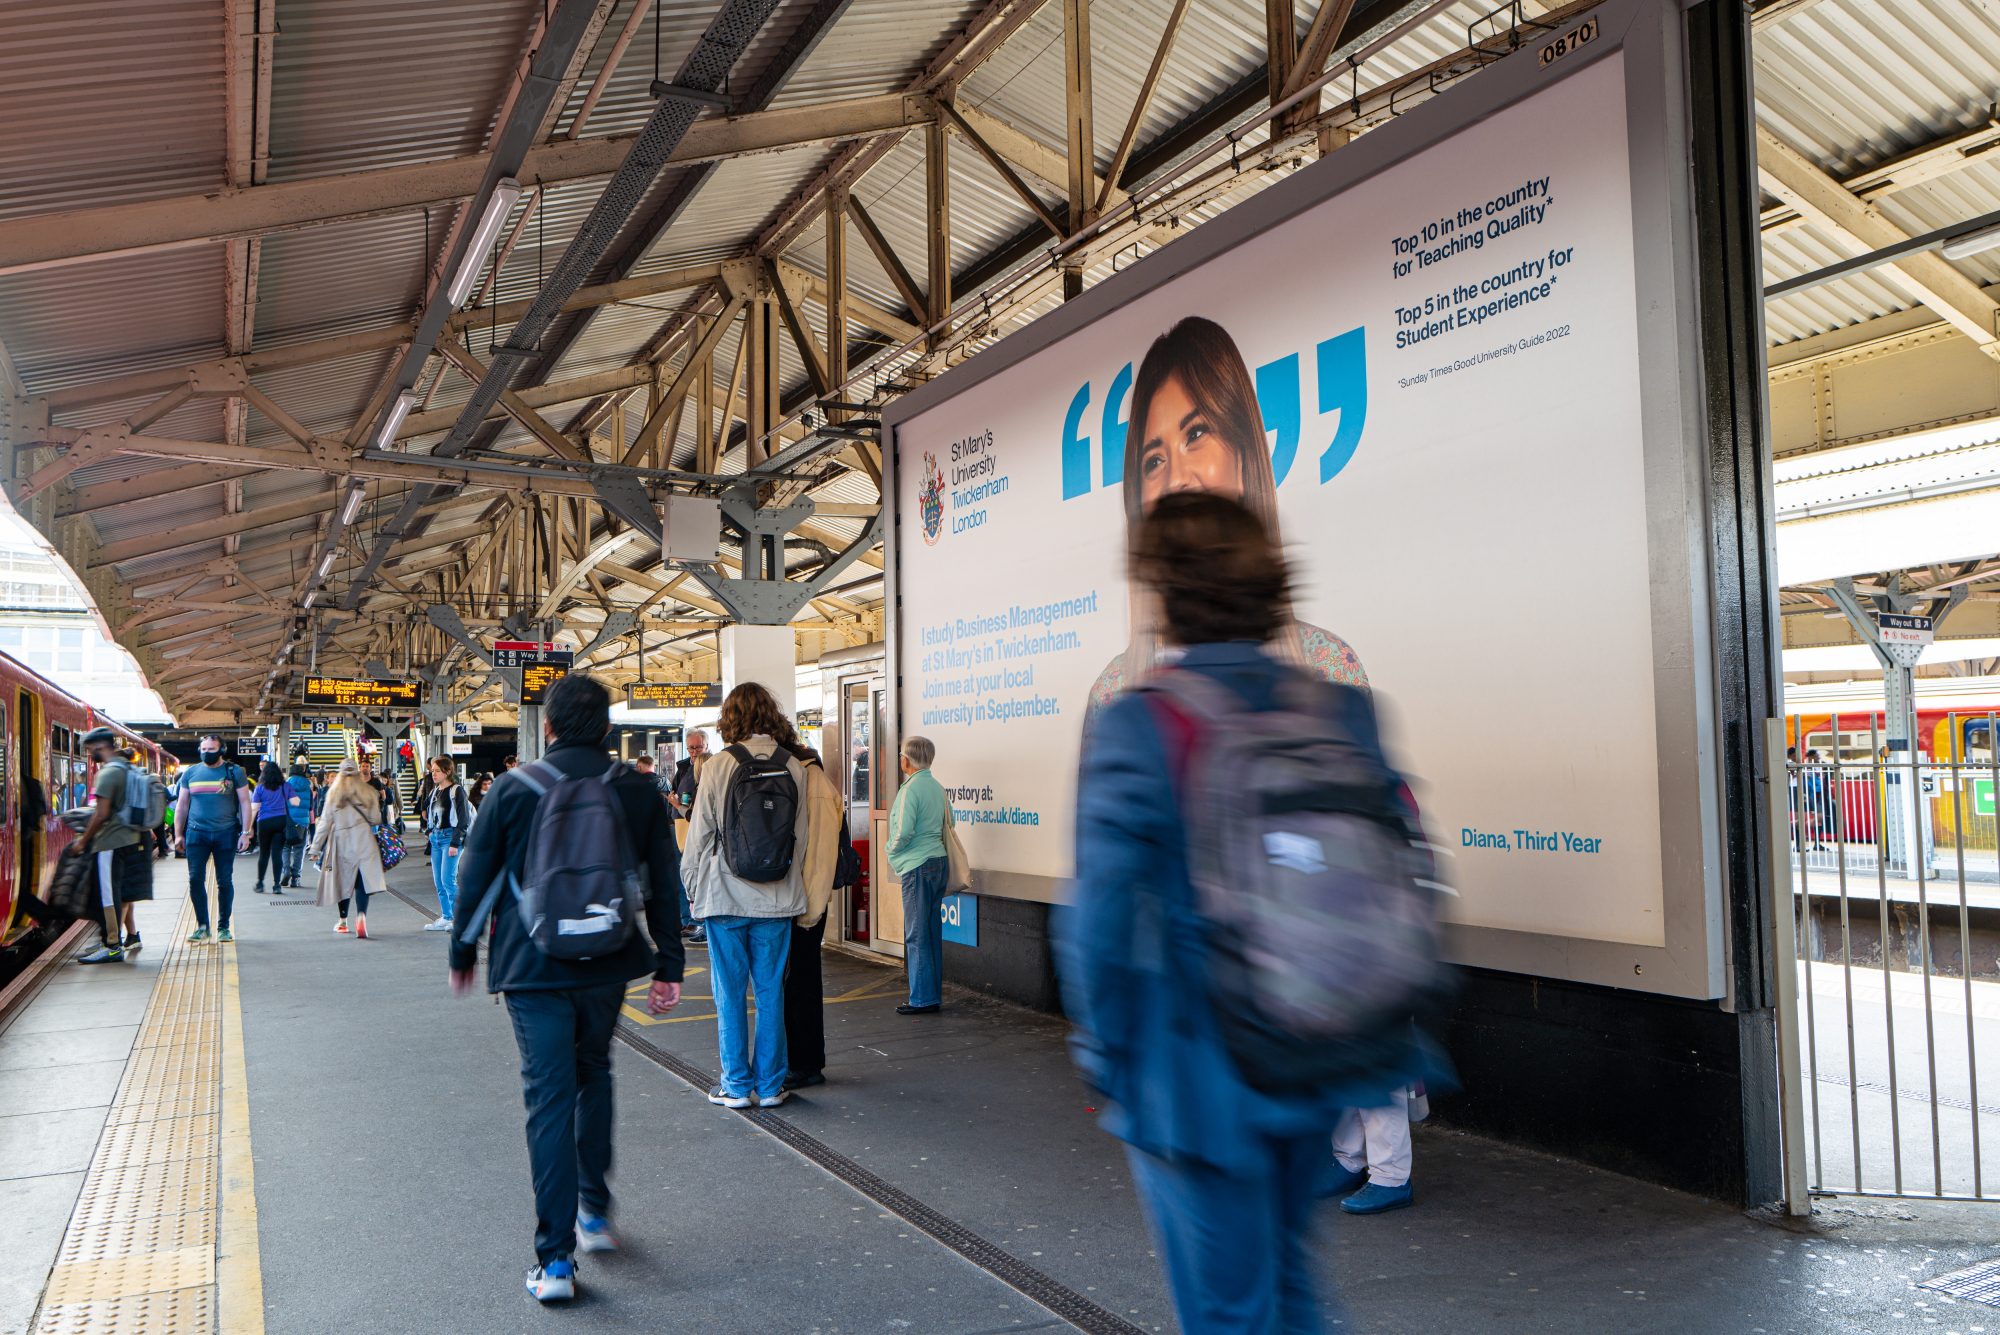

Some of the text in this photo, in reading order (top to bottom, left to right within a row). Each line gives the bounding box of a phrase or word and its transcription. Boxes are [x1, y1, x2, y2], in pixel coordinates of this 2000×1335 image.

[1543, 24, 1591, 63] 0870
[1392, 176, 1550, 256] Top 10 in the country
[1393, 260, 1413, 279] for
[1415, 229, 1484, 269] Teaching
[1395, 247, 1574, 326] Top 5 in the country for
[1396, 314, 1454, 349] Student
[1429, 363, 1453, 379] Times
[1453, 355, 1476, 371] Good
[1476, 342, 1518, 364] University
[1518, 333, 1545, 350] Guide
[1546, 324, 1571, 342] 2022
[951, 428, 993, 462] St Mary's
[951, 455, 996, 486] University
[951, 475, 1009, 510] Twickenham
[952, 509, 987, 534] London
[921, 590, 1097, 646] I study Business Management
[1890, 618, 1902, 628] Way
[520, 651, 535, 660] Way
[922, 630, 1081, 673] at St Mary's in Twickenham.
[922, 664, 1034, 699] Join me at your local
[336, 695, 391, 705] 15:31:47
[656, 699, 703, 707] 15:31:47
[922, 694, 1060, 726] university in September.
[315, 722, 325, 734] 8
[863, 724, 870, 734] 6
[944, 785, 993, 804] my story at:
[952, 806, 1039, 826] marys.ac.uk/diana
[1461, 828, 1602, 853] Diana, Third Year
